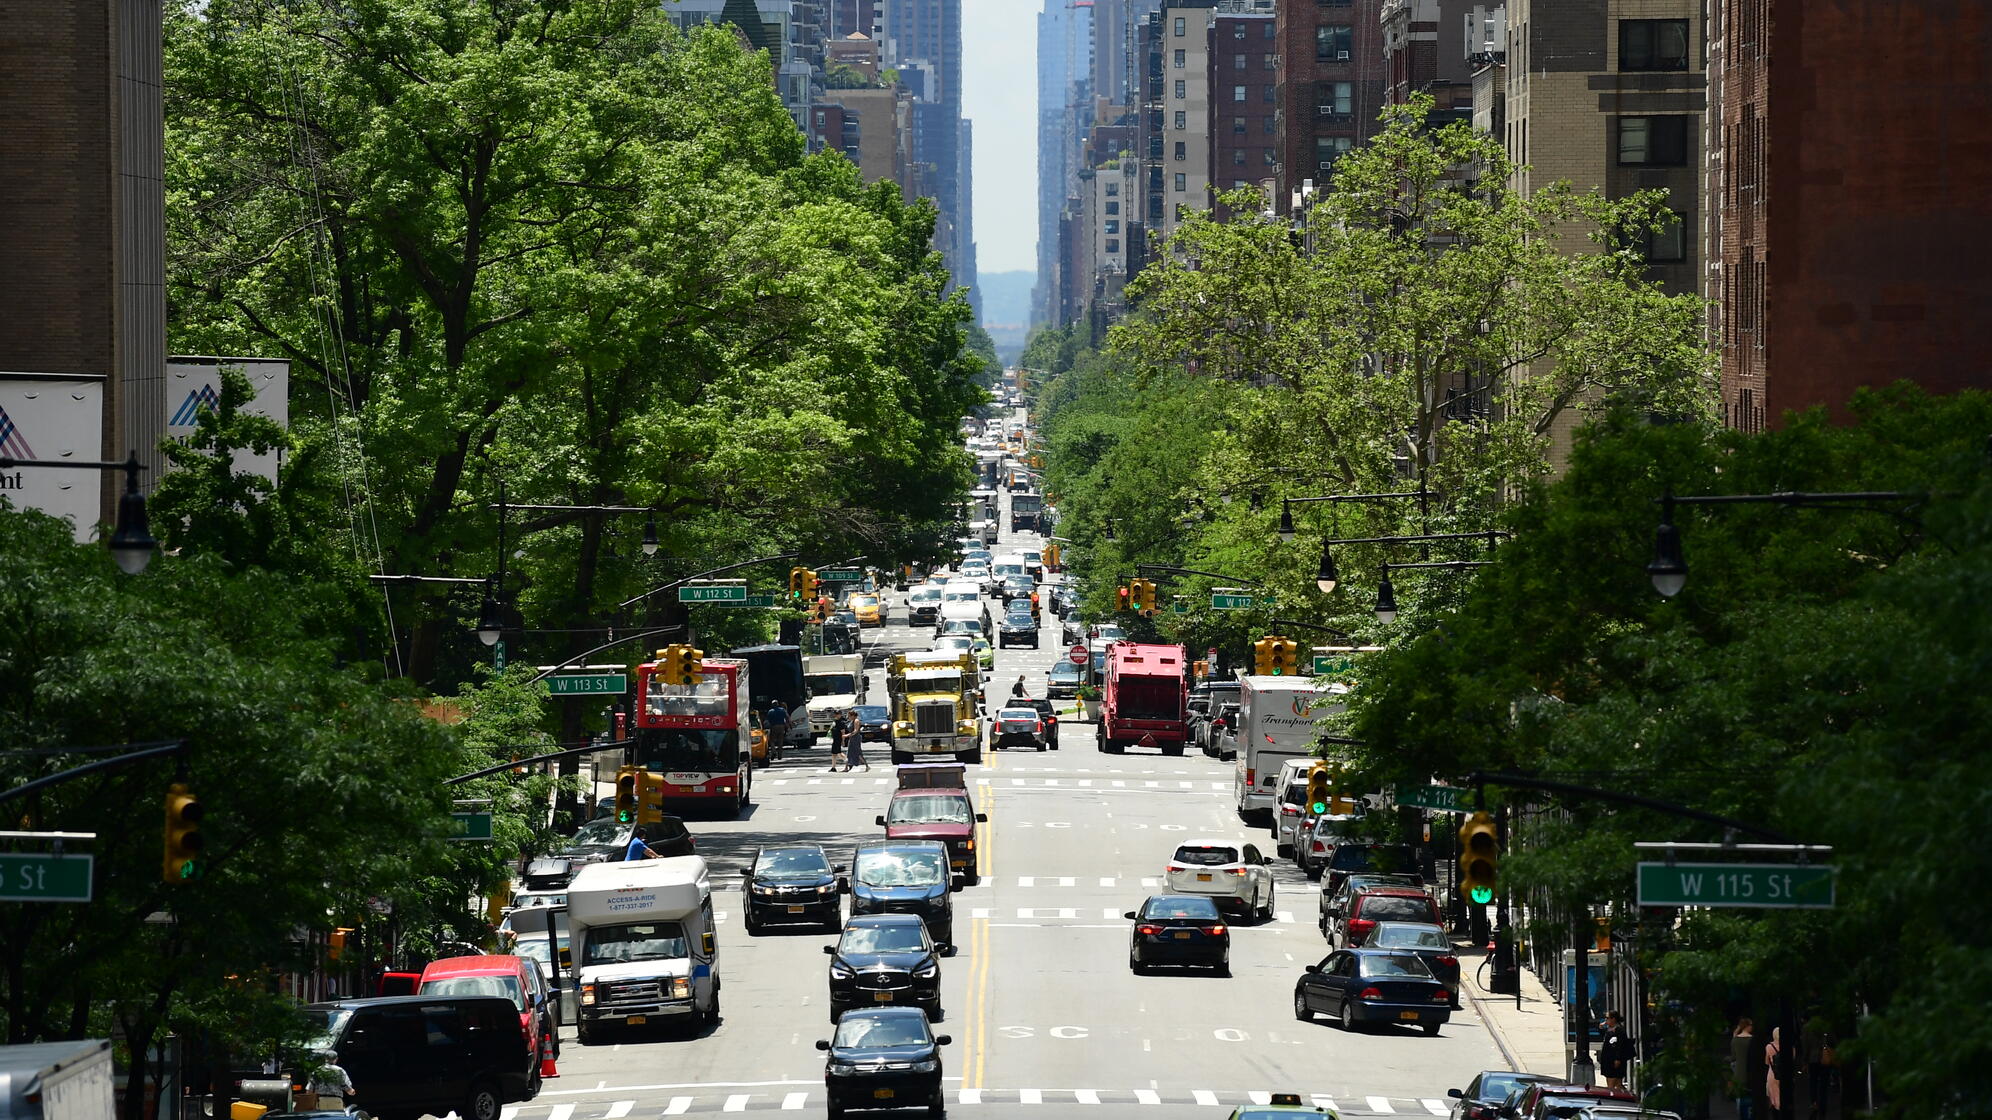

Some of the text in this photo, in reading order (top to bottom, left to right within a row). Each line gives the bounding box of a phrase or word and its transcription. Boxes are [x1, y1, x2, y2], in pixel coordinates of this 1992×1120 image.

[693, 588, 733, 599] W 112 St
[754, 597, 763, 606] St
[1226, 597, 1251, 607] W 112
[557, 679, 608, 691] W 113 St
[1435, 790, 1456, 806] 114
[19, 864, 46, 890] St
[1680, 872, 1793, 898] W 115 St
[607, 894, 657, 904] ACCESS-A-RIDE
[609, 902, 654, 911] 1-877-337-2017
